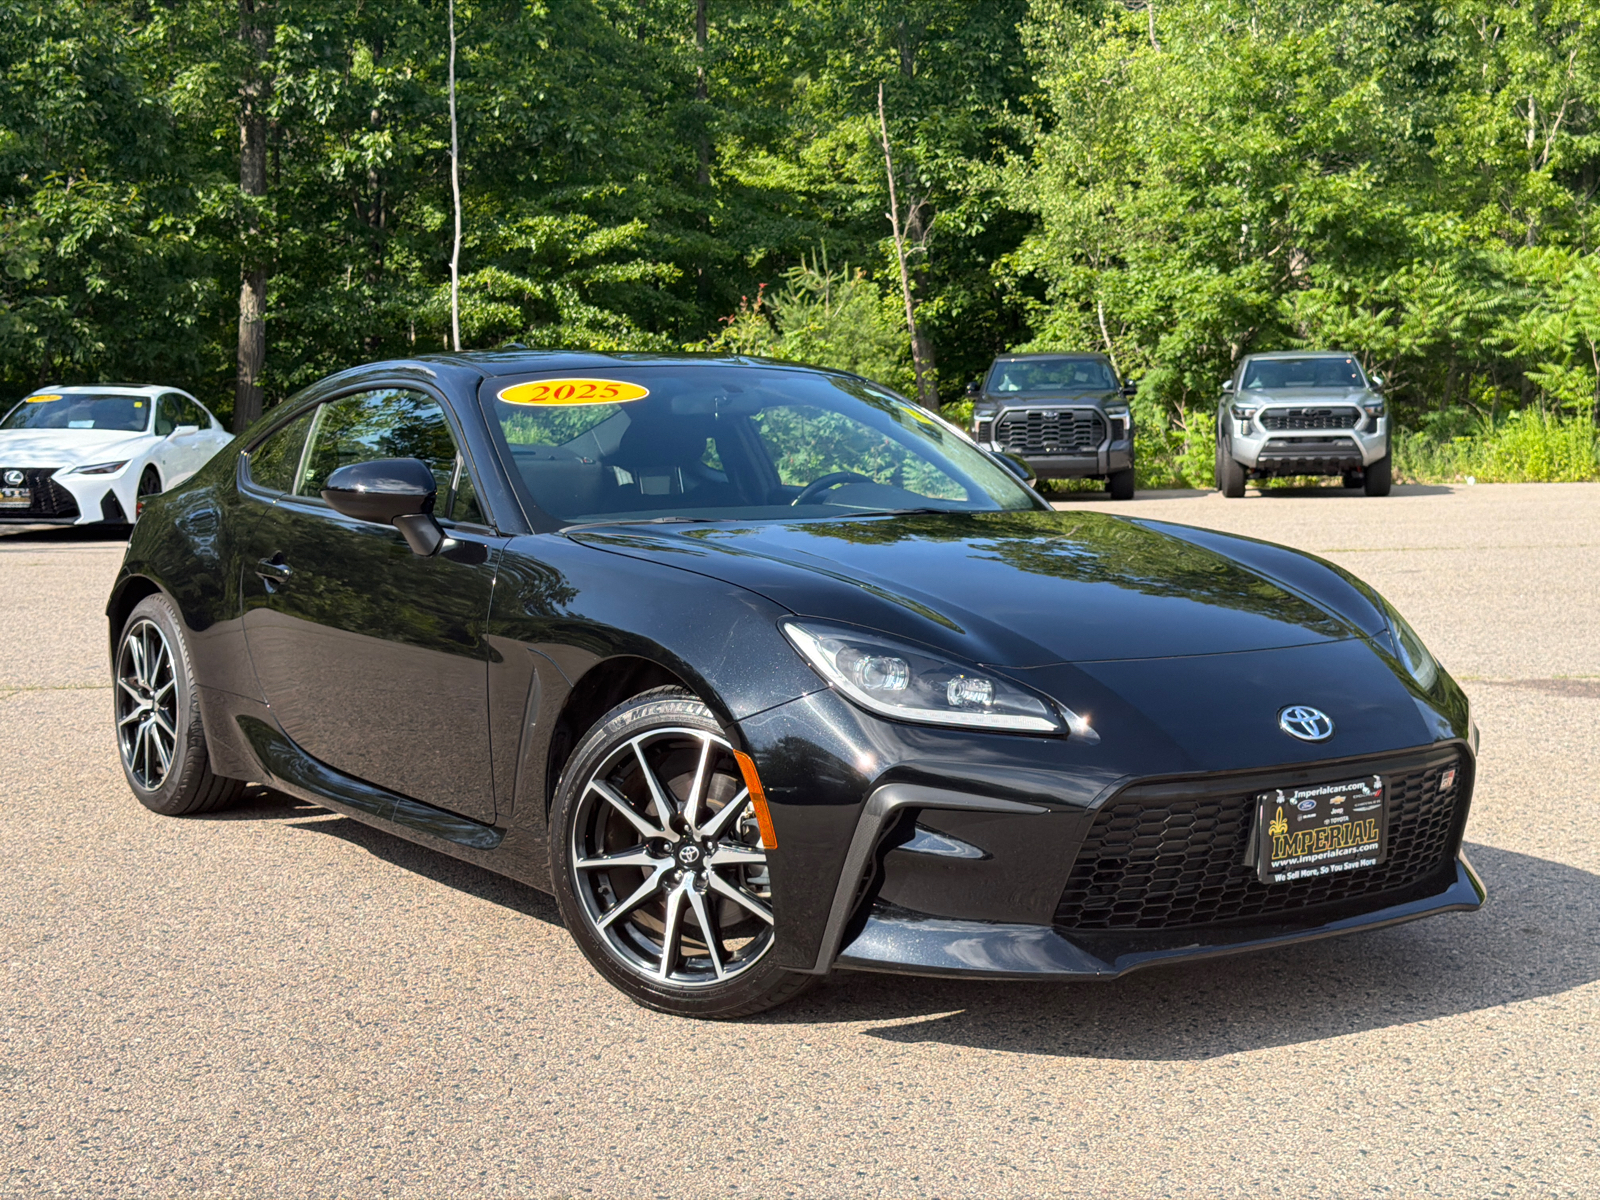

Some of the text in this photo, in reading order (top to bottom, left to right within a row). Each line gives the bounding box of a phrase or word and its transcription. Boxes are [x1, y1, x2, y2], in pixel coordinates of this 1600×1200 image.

[529, 384, 621, 402] 2025
[1294, 782, 1366, 799] Imperialcars.com
[1271, 818, 1379, 860] IMPERIAL
[1271, 843, 1379, 868] www.imperialcars.com
[1274, 873, 1286, 882] We
[1287, 871, 1300, 880] Sell
[1320, 866, 1329, 874] So
[1330, 863, 1343, 873] You
[1344, 861, 1360, 871] Save
[1360, 858, 1377, 867] More
